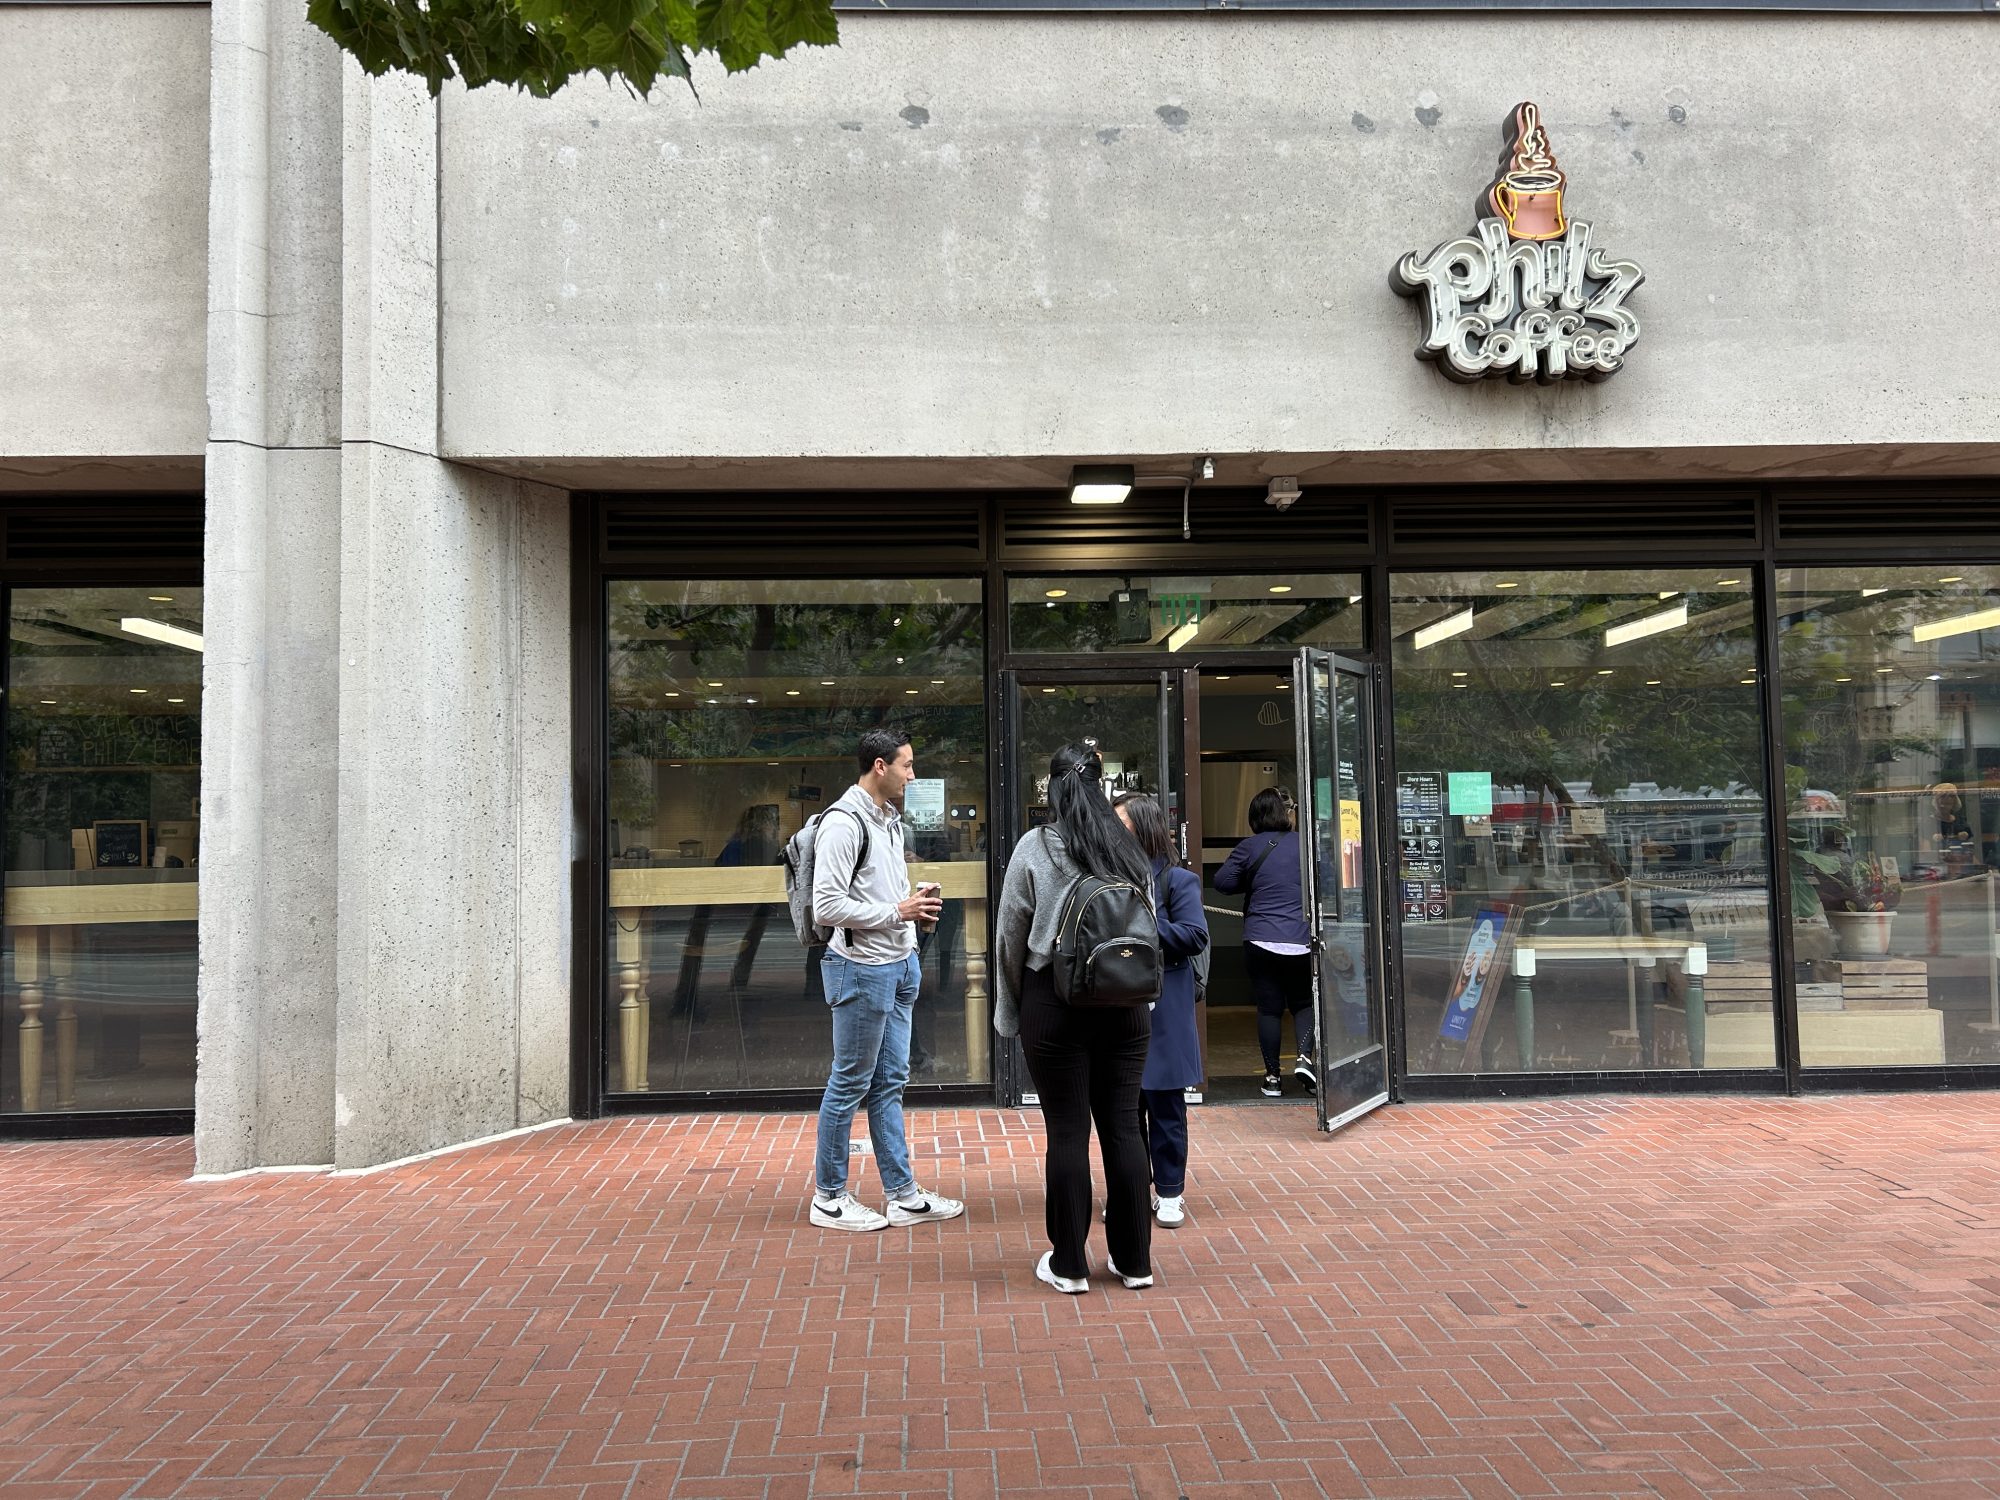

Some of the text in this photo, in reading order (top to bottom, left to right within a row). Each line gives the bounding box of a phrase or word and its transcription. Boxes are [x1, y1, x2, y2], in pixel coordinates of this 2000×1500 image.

[1397, 216, 1646, 350] Philz
[1445, 309, 1627, 378] Coffee
[70, 715, 189, 742] WELCOME
[1558, 720, 1593, 738] with
[1599, 719, 1637, 736] love
[82, 740, 141, 765] PHILZ
